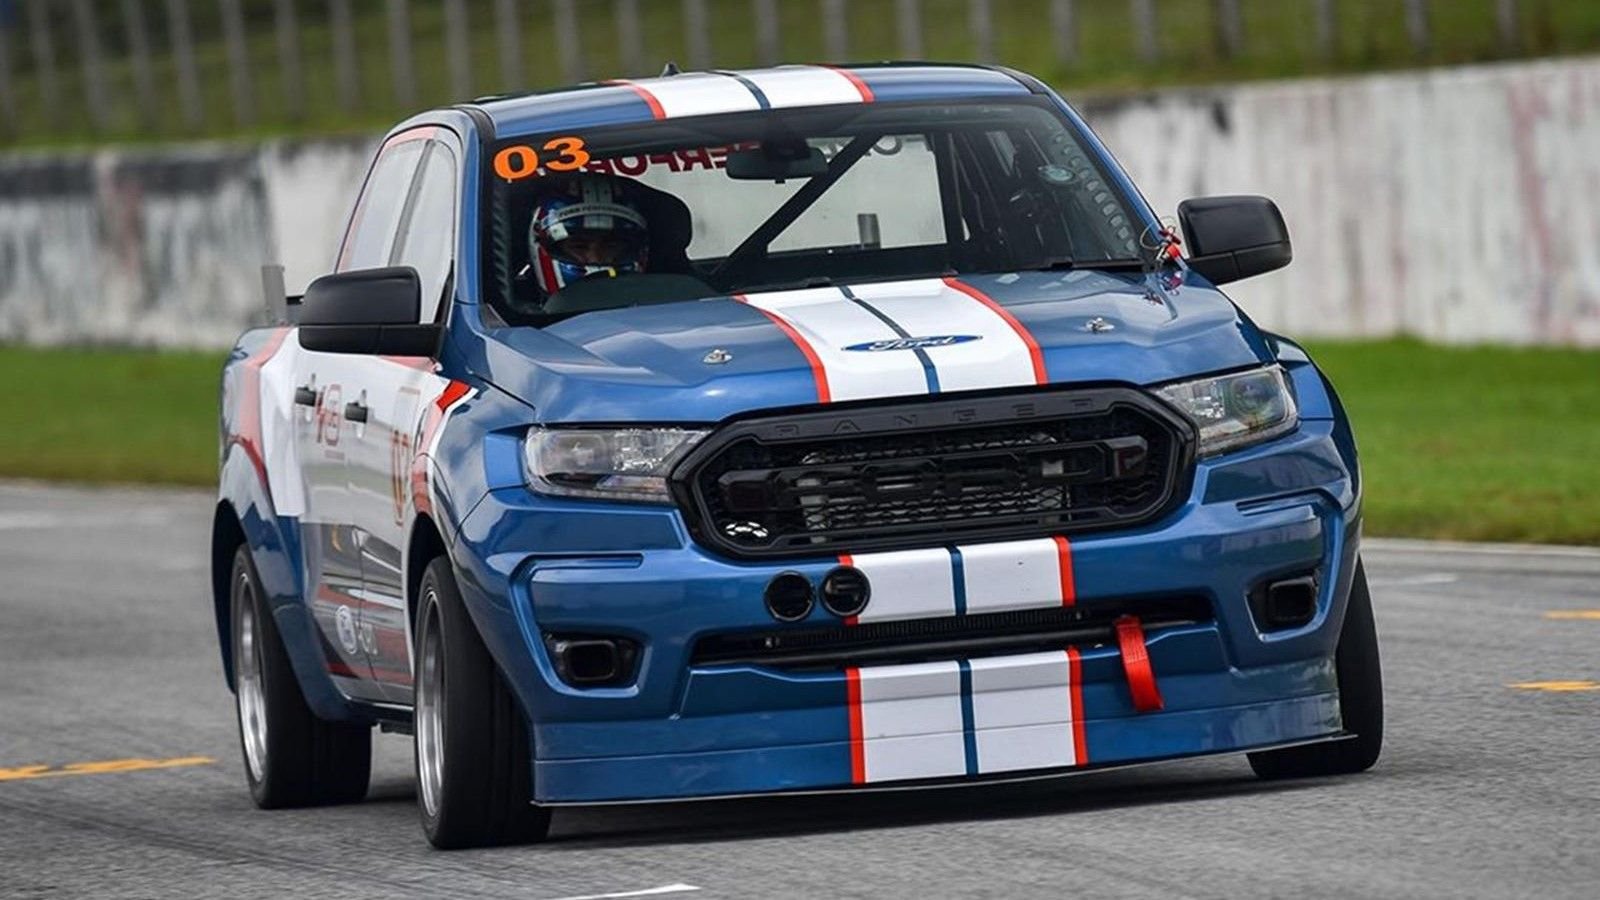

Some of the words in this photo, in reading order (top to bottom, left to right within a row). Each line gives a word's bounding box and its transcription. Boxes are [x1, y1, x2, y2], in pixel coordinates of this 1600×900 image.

[493, 136, 591, 180] 03
[868, 336, 955, 351] Ford
[775, 397, 1095, 438] RANGER
